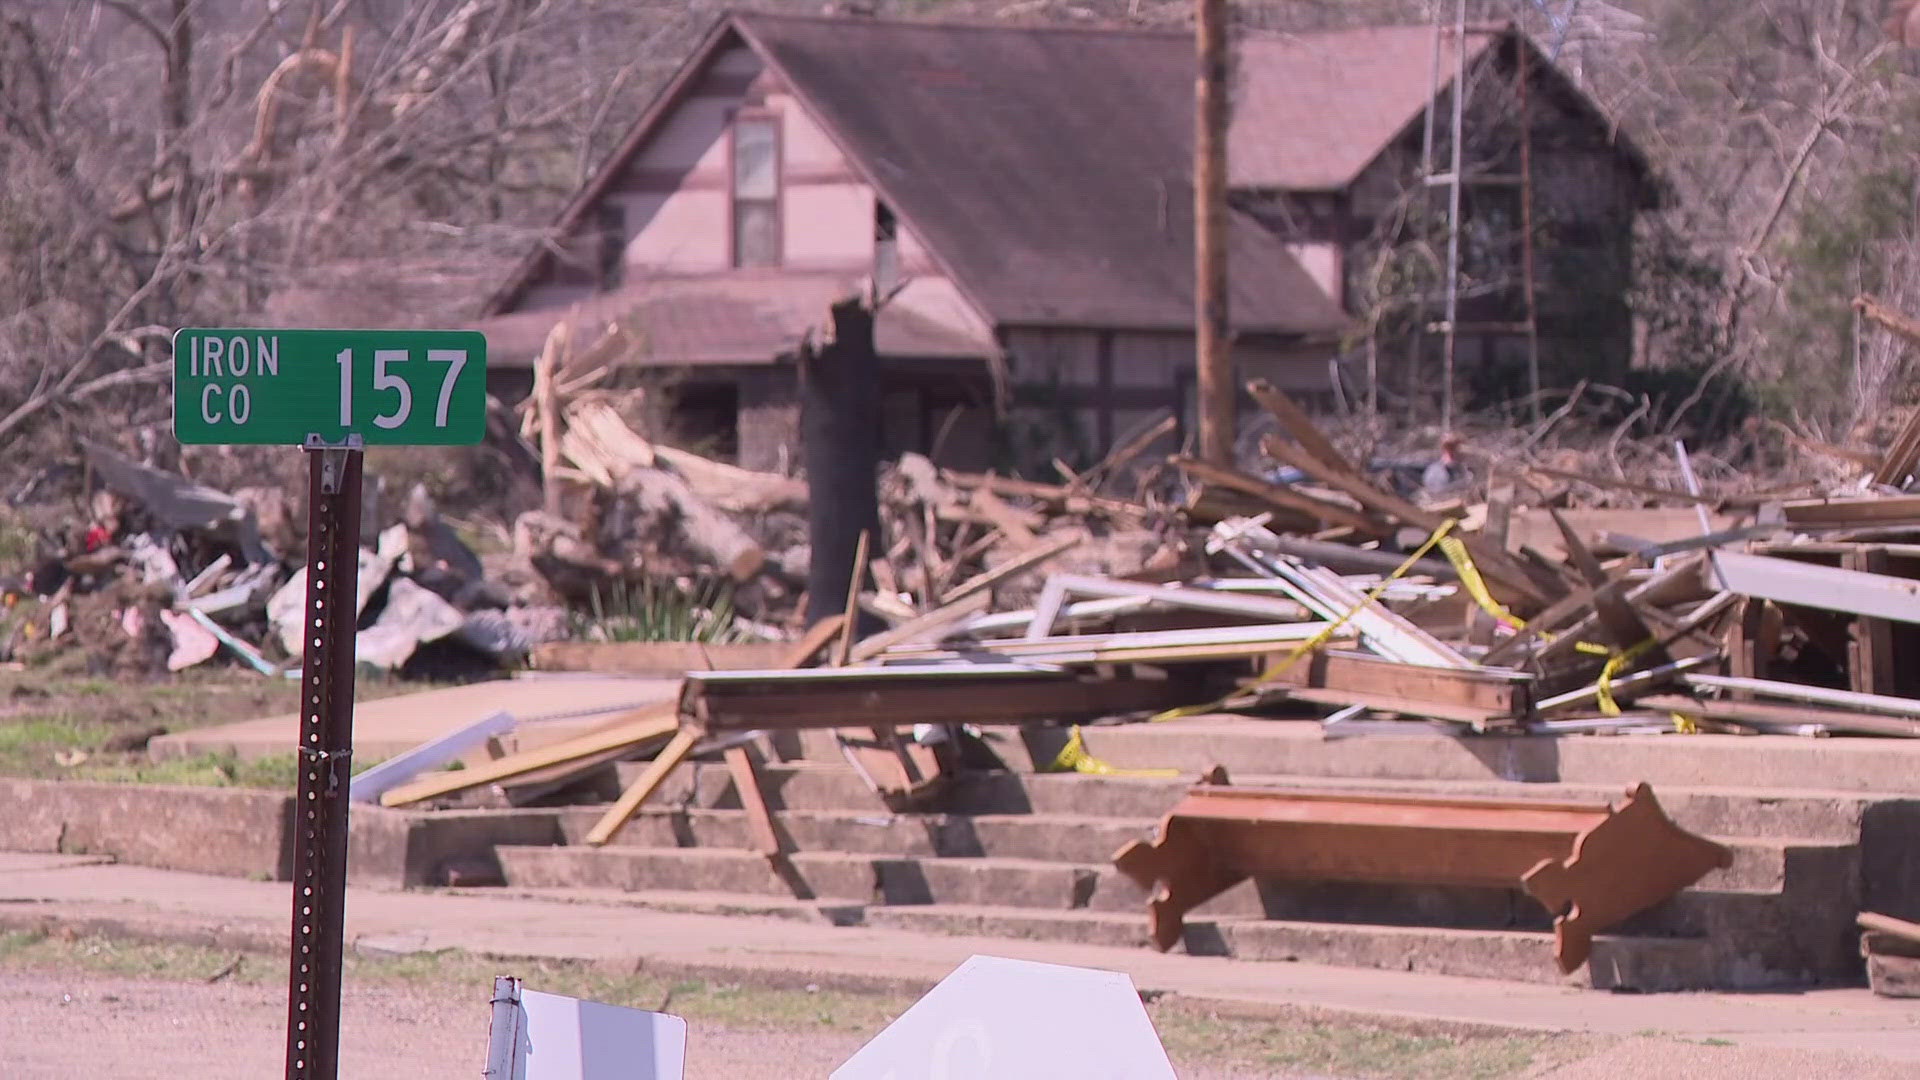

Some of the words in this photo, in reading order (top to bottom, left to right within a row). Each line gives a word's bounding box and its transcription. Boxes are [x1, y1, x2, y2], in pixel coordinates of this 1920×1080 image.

[190, 335, 278, 377] IRON
[201, 383, 250, 424] CO
[336, 348, 468, 429] 157
